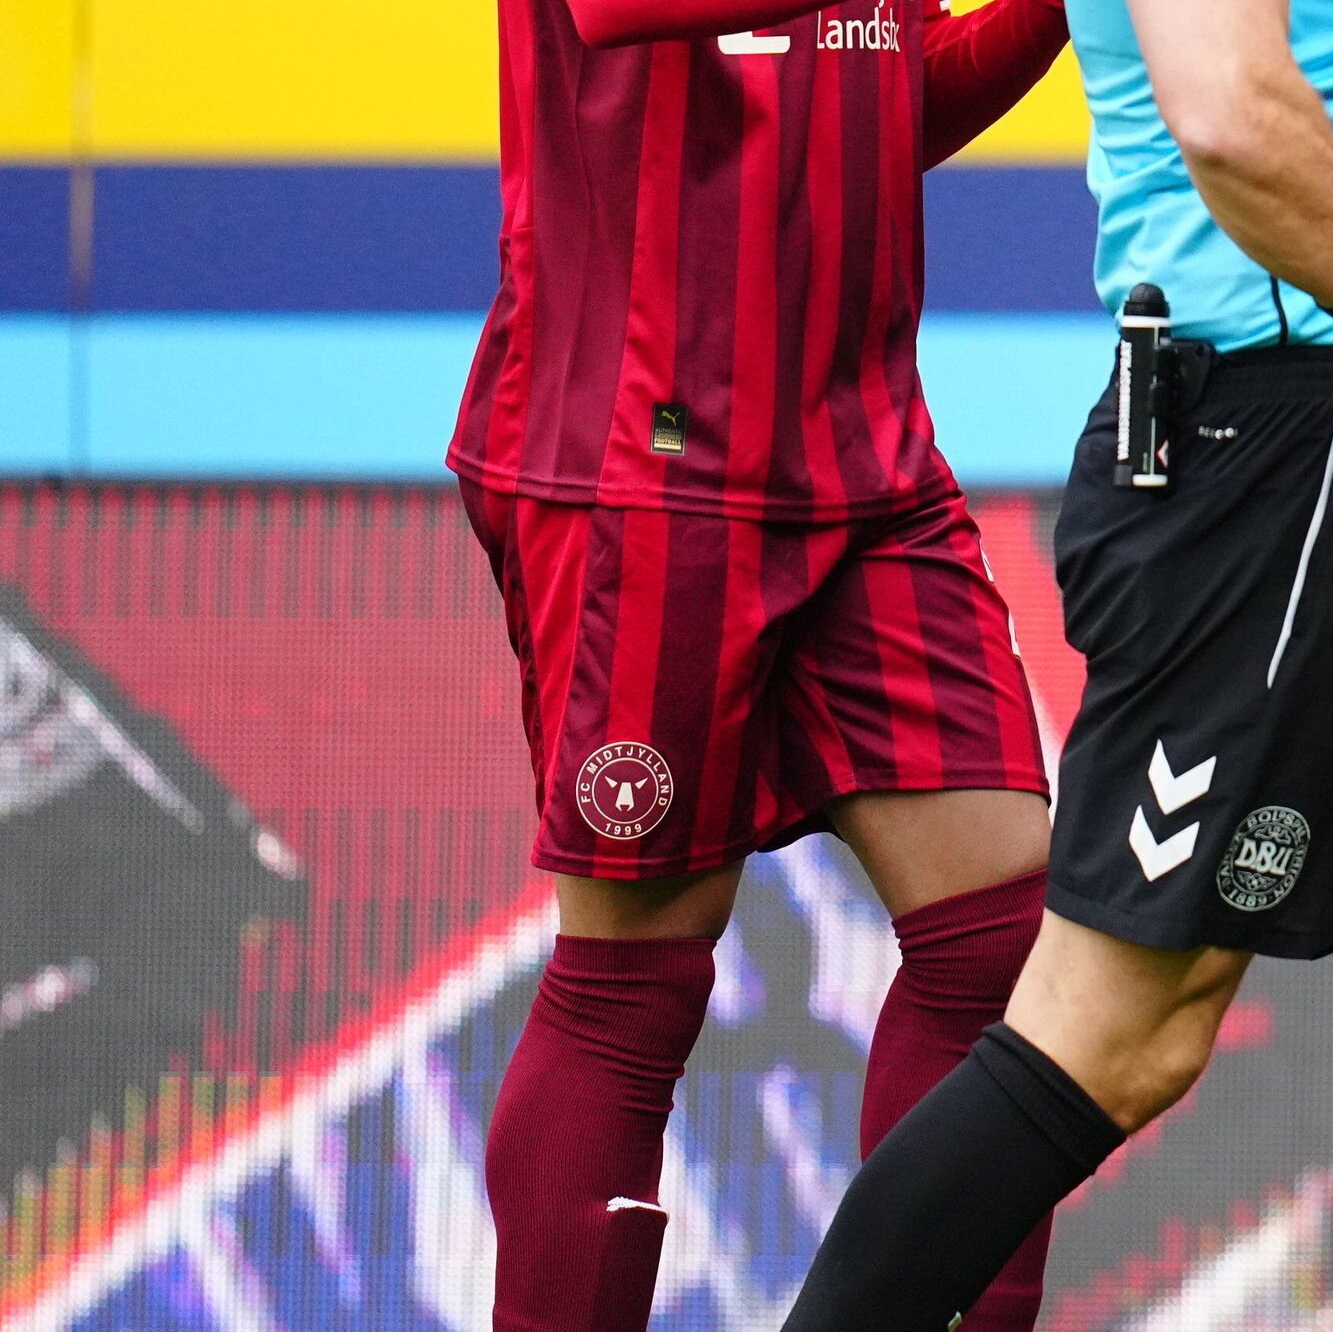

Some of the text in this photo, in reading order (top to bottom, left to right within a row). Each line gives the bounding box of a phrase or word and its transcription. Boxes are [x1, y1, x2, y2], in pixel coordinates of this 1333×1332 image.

[580, 746, 670, 807] FC MIDTJYLLAND
[604, 822, 643, 837] 1999
[1234, 837, 1294, 876] DBU
